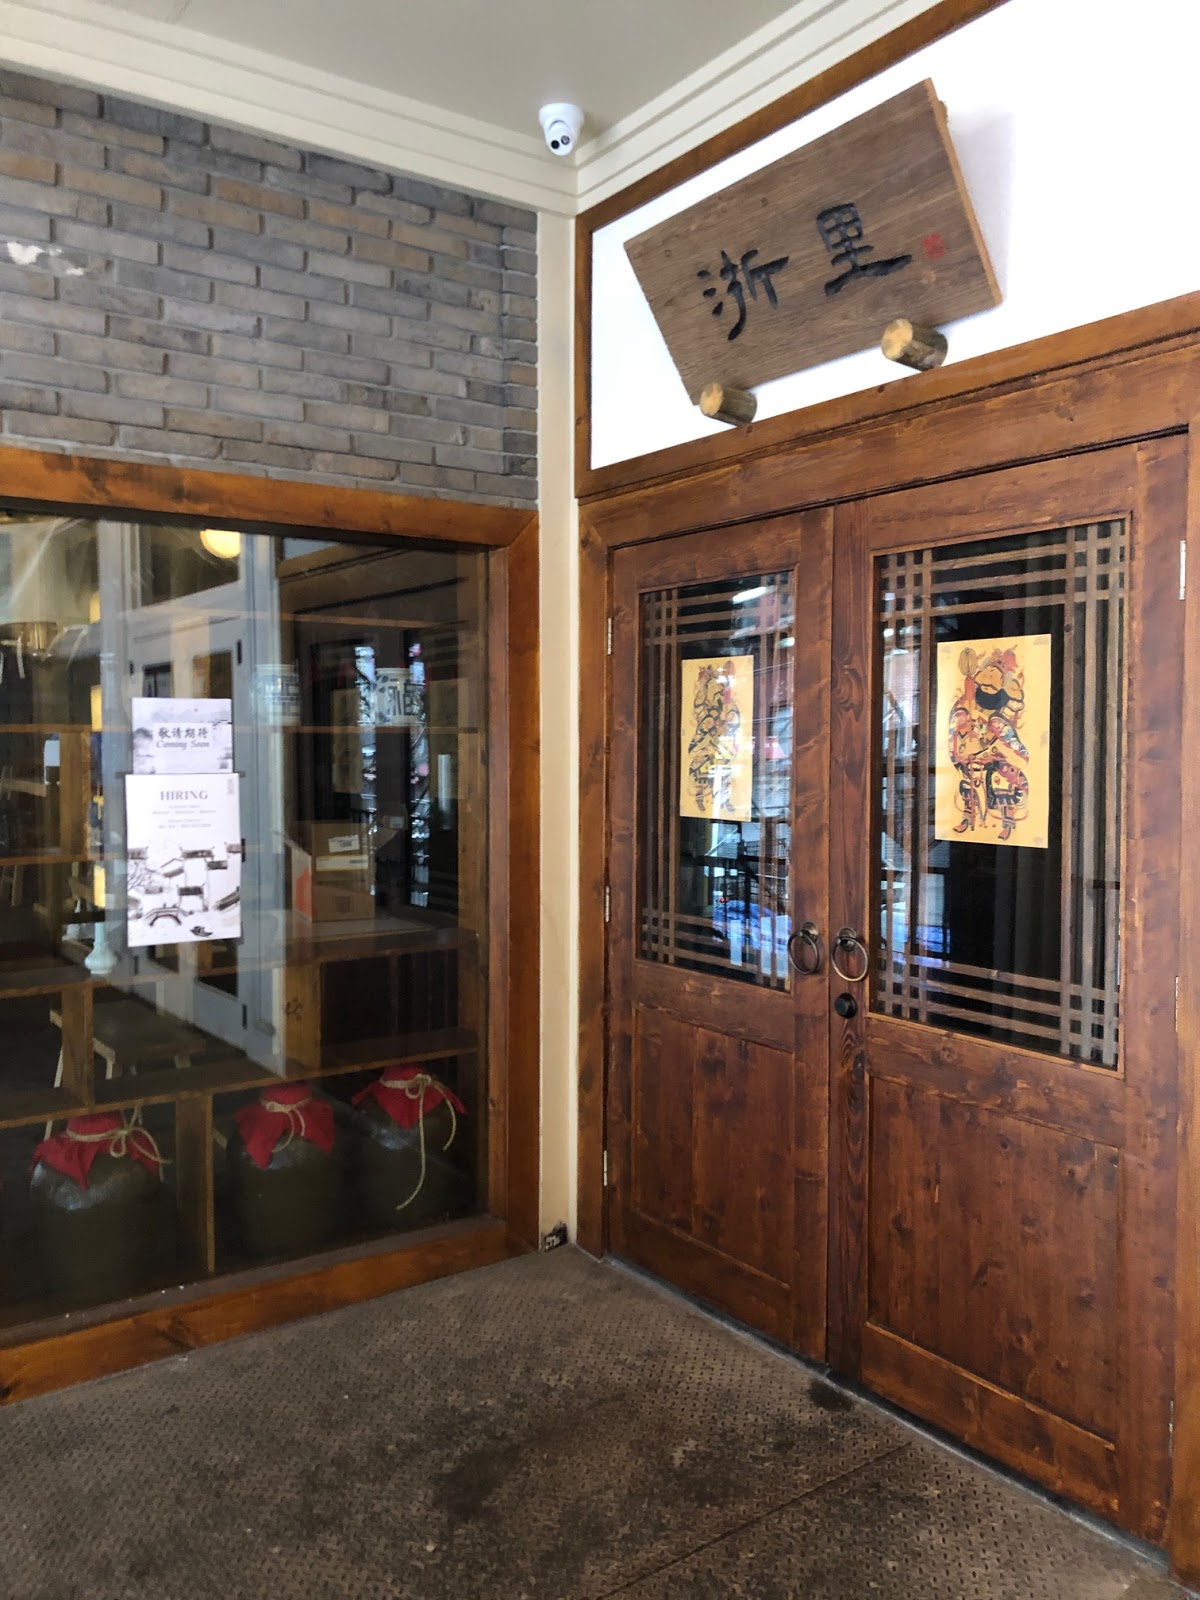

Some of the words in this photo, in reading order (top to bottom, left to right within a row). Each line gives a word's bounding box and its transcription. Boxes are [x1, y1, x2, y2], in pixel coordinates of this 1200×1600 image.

[696, 201, 913, 341] 浙里
[158, 727, 208, 739] 敬请期待
[156, 740, 187, 751] Coming
[190, 739, 210, 748] Soon
[160, 790, 209, 801] HIRING
